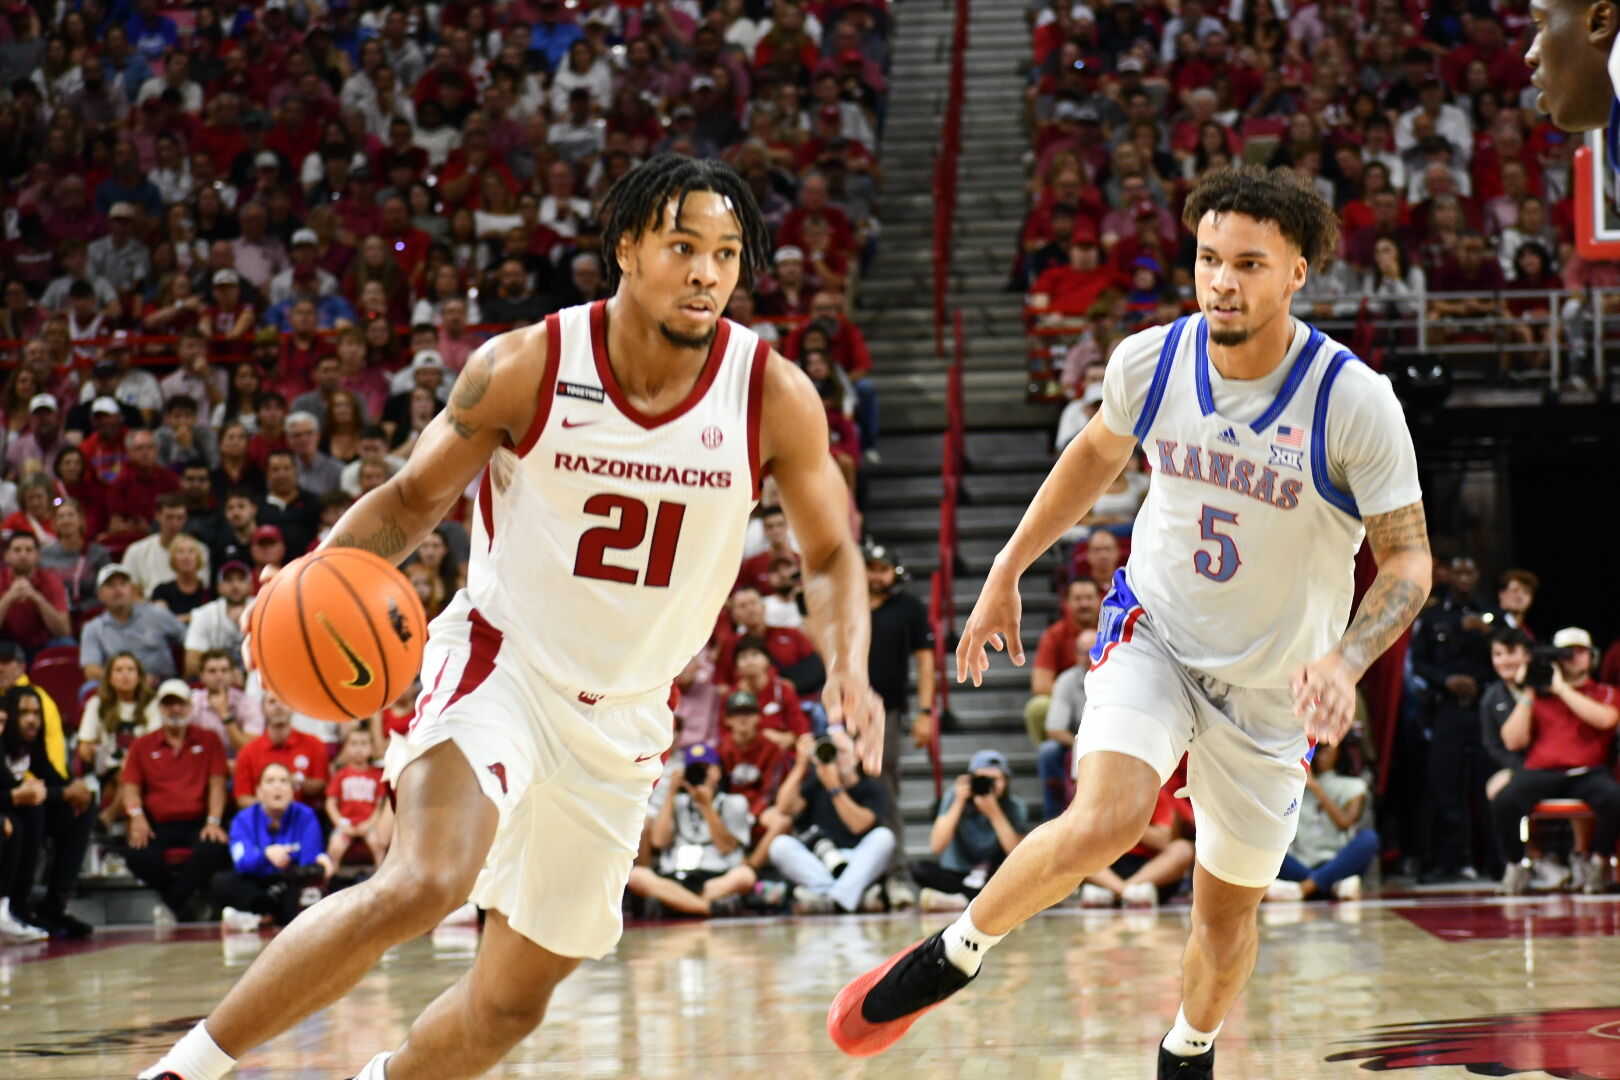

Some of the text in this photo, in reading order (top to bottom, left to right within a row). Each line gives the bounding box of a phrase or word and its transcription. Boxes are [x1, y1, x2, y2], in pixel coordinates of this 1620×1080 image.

[566, 384, 603, 401] TOGETHER
[554, 452, 731, 488] RAZORBACKS
[1156, 437, 1303, 510] KANSAS
[573, 493, 686, 588] 21
[1193, 504, 1242, 582] 5
